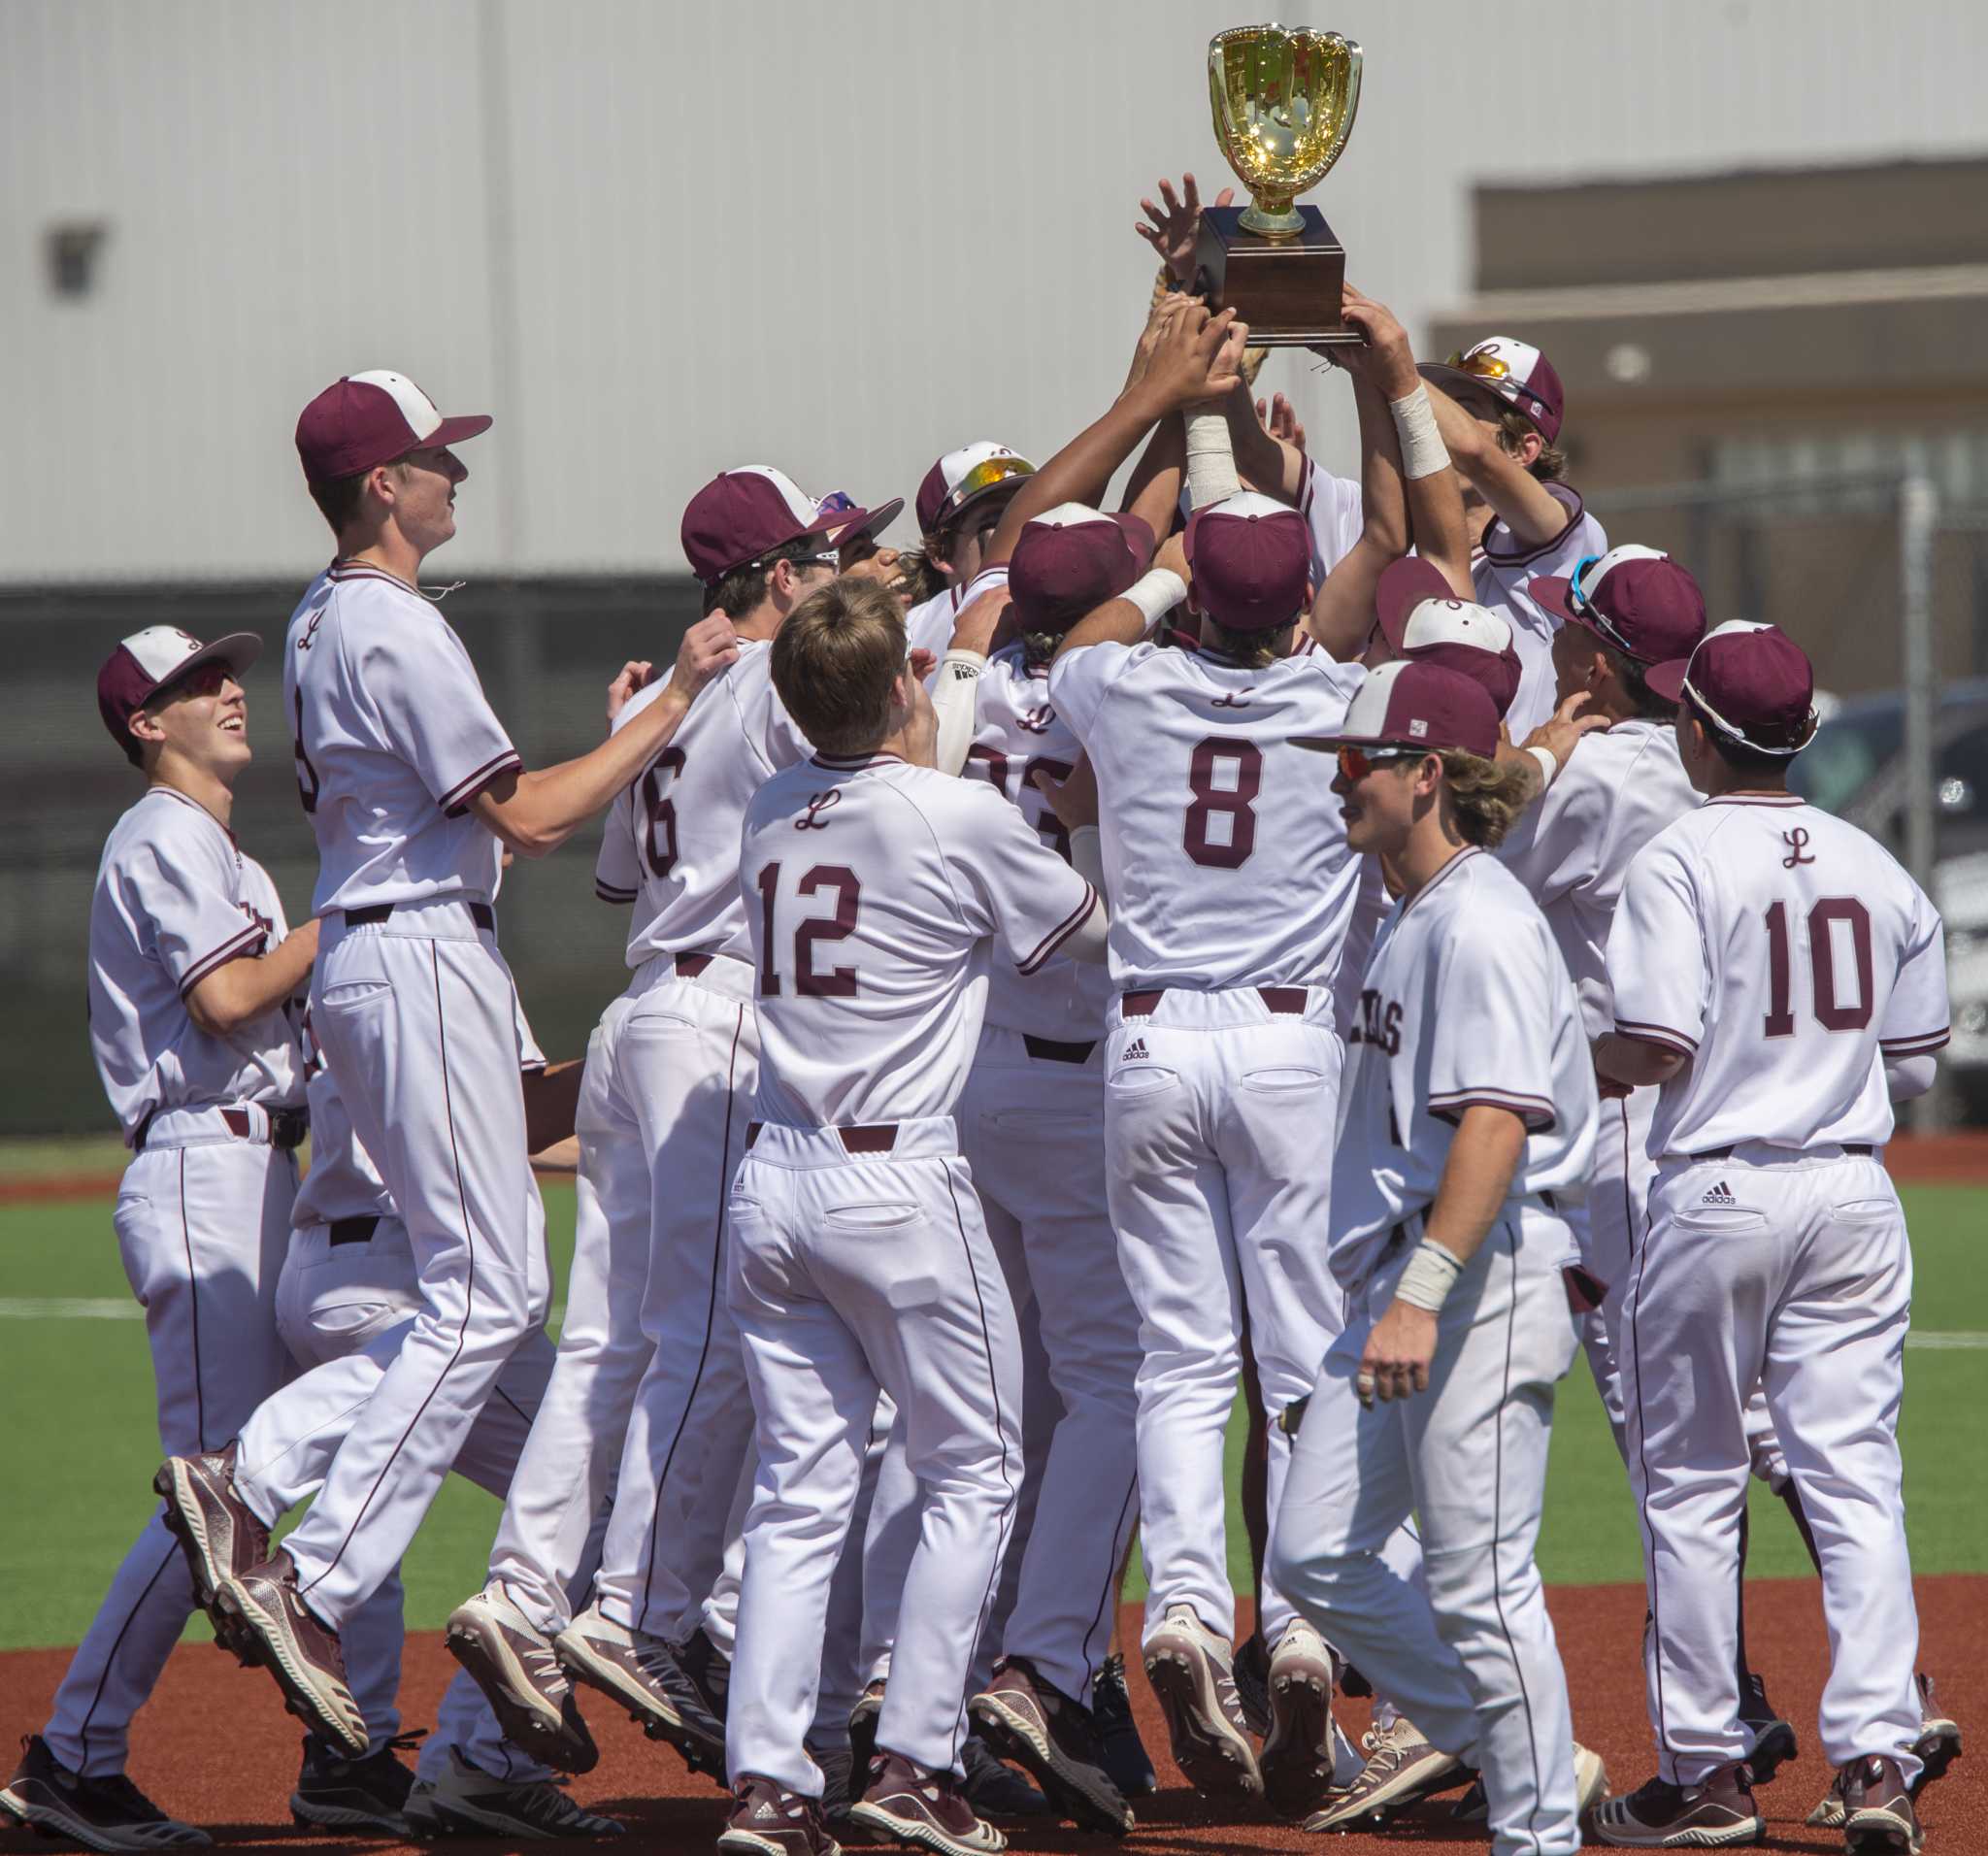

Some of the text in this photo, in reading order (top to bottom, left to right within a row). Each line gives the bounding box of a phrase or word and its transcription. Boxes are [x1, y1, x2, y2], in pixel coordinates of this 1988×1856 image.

[794, 788, 843, 830] L
[1181, 733, 1266, 872] 8
[1782, 827, 1816, 869] L
[757, 859, 863, 999] 12
[1763, 894, 1875, 1041] 10
[1702, 1195, 1737, 1205] adidas
